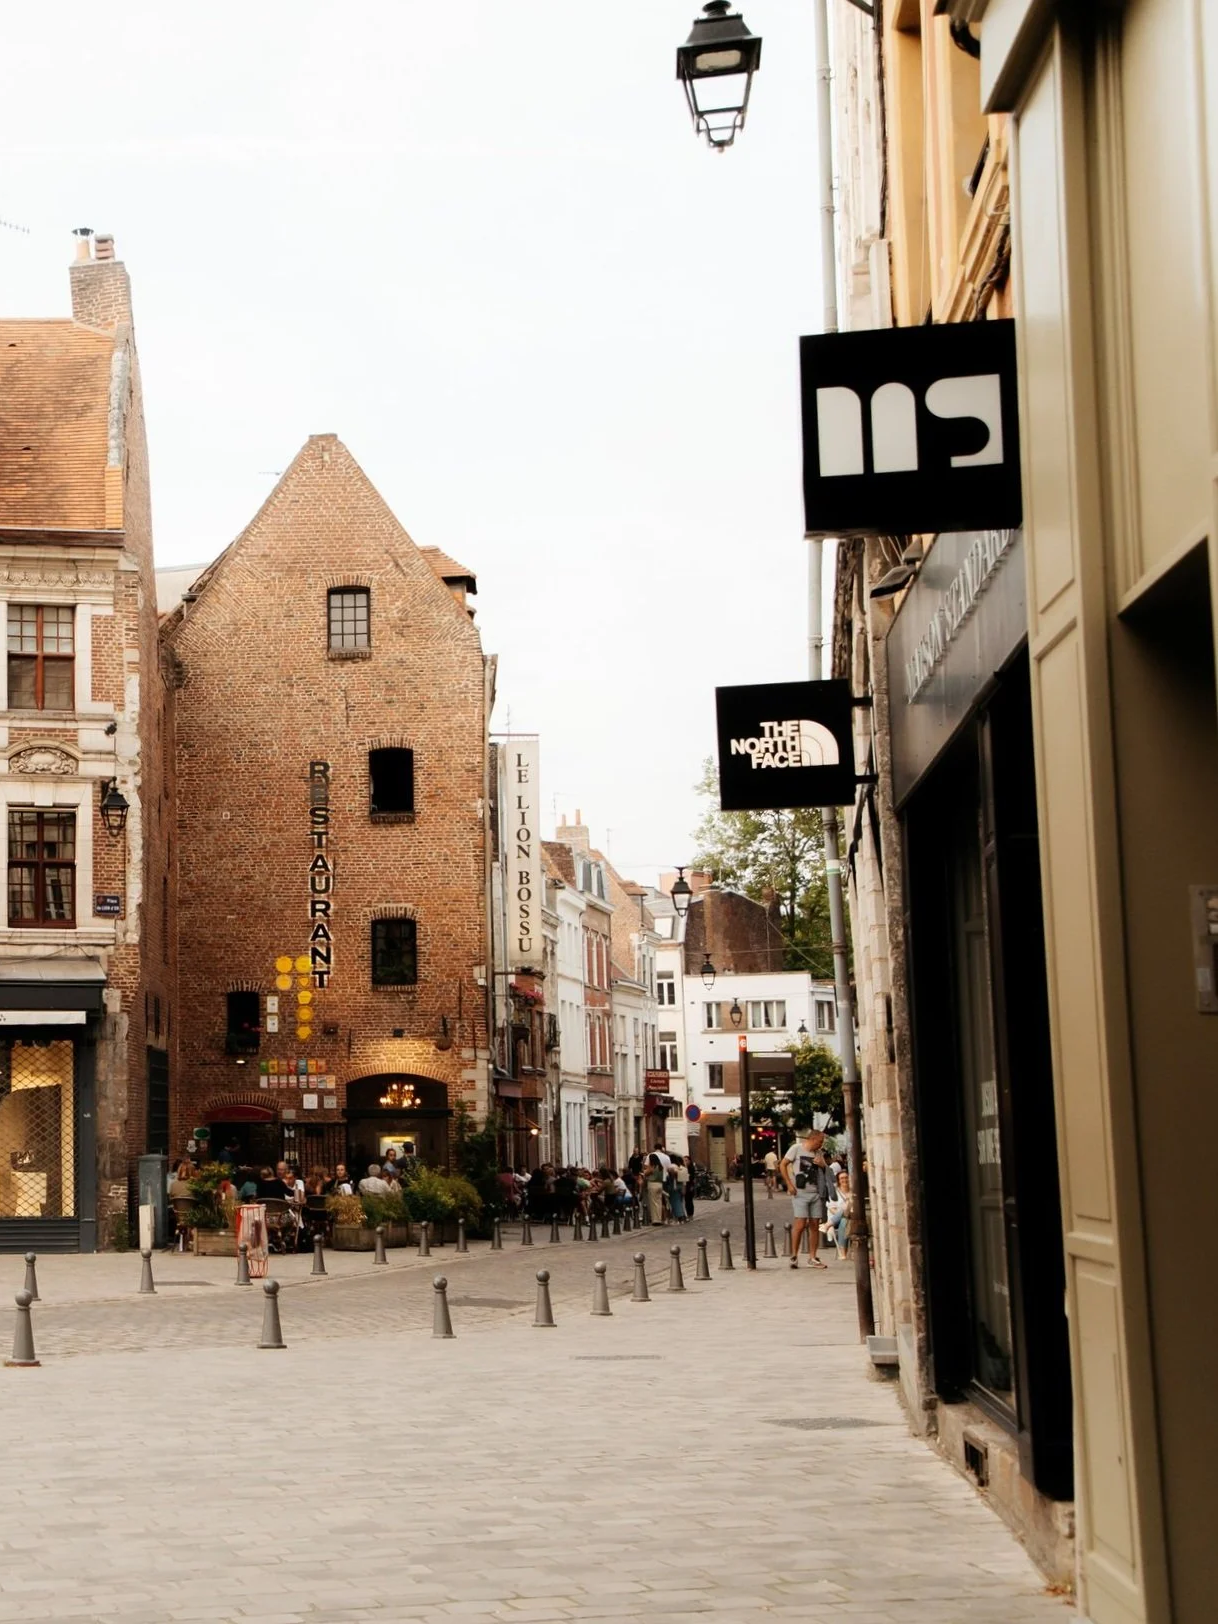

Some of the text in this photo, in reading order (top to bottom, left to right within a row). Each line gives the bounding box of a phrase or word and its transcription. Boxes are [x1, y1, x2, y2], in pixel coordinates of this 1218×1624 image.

[760, 720, 800, 738] THE
[730, 736, 800, 756] NORTH
[751, 751, 801, 769] FACE
[516, 753, 533, 953] LE LION BOSSU
[308, 761, 332, 989] RESTAURANT
